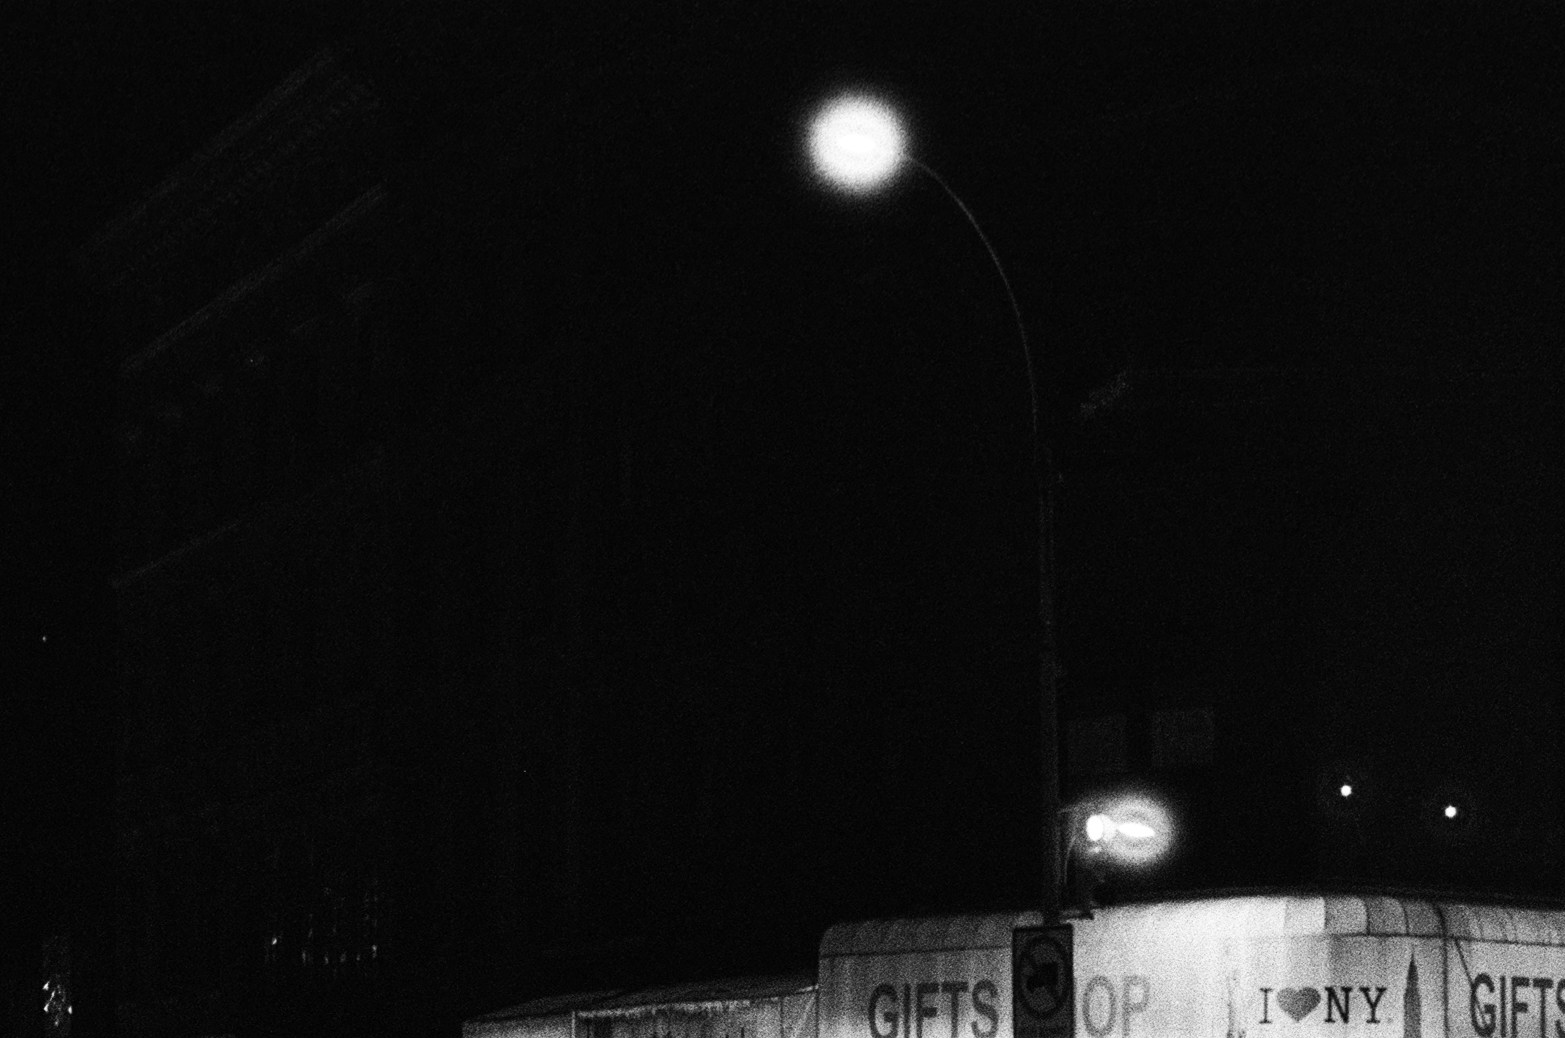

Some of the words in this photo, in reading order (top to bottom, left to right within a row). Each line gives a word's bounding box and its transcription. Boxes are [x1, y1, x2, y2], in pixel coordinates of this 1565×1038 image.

[1074, 975, 1151, 1038] OP
[1259, 988, 1273, 1025] I
[1324, 986, 1388, 1025] NY
